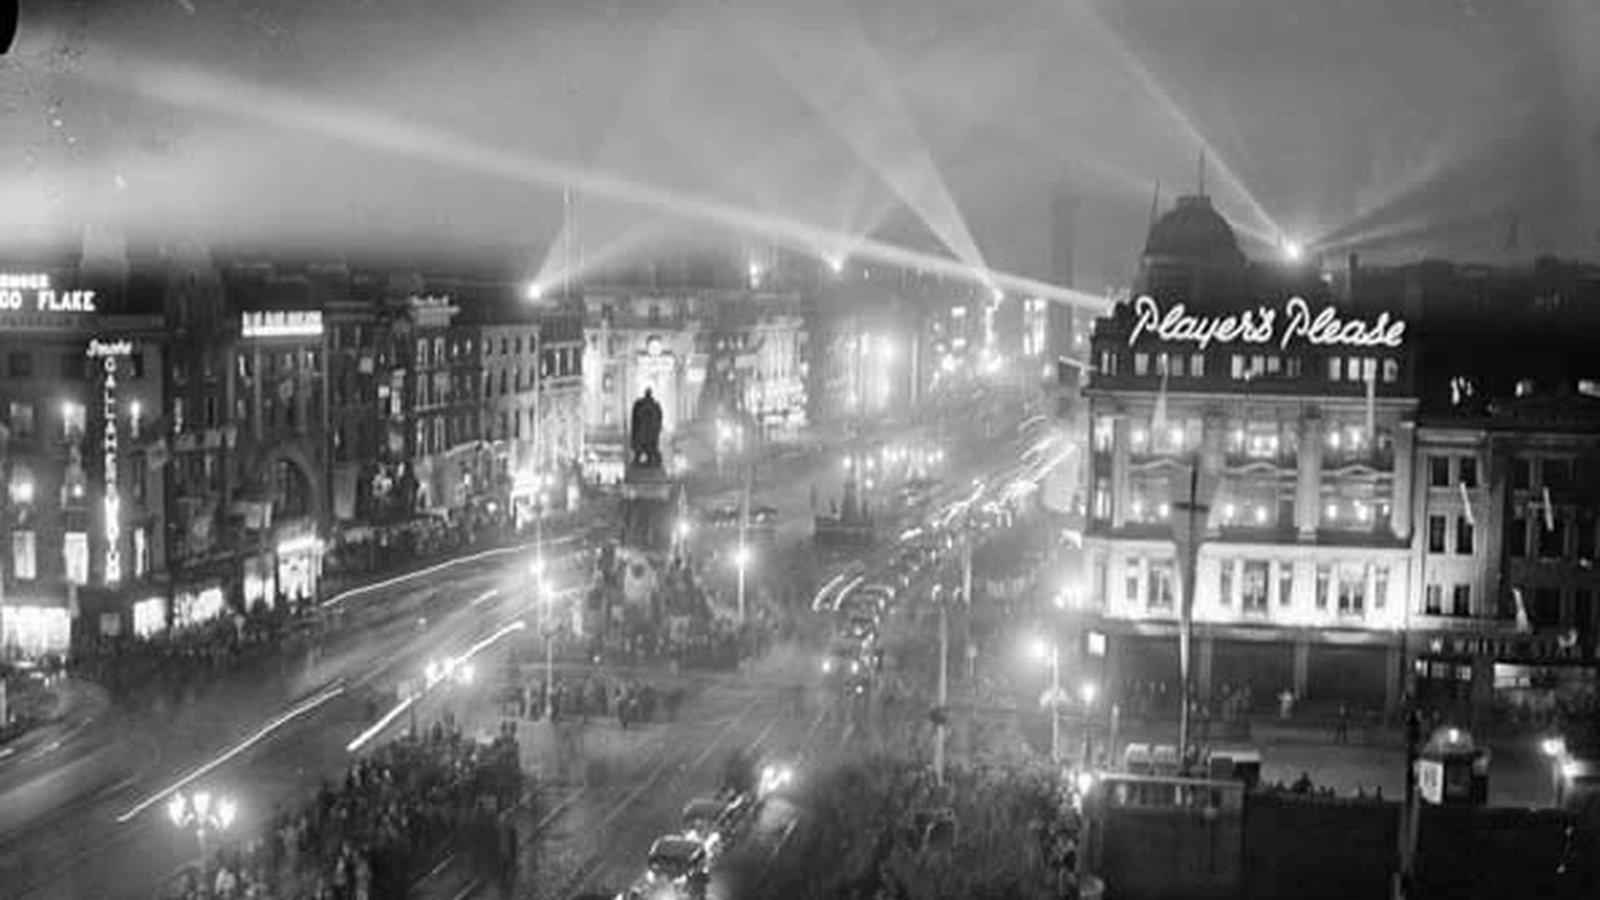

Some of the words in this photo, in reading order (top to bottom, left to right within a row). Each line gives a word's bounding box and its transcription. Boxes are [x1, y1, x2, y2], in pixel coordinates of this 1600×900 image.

[37, 289, 97, 311] FLAKE
[1128, 296, 1276, 350] Player's
[1280, 296, 1406, 350] Please
